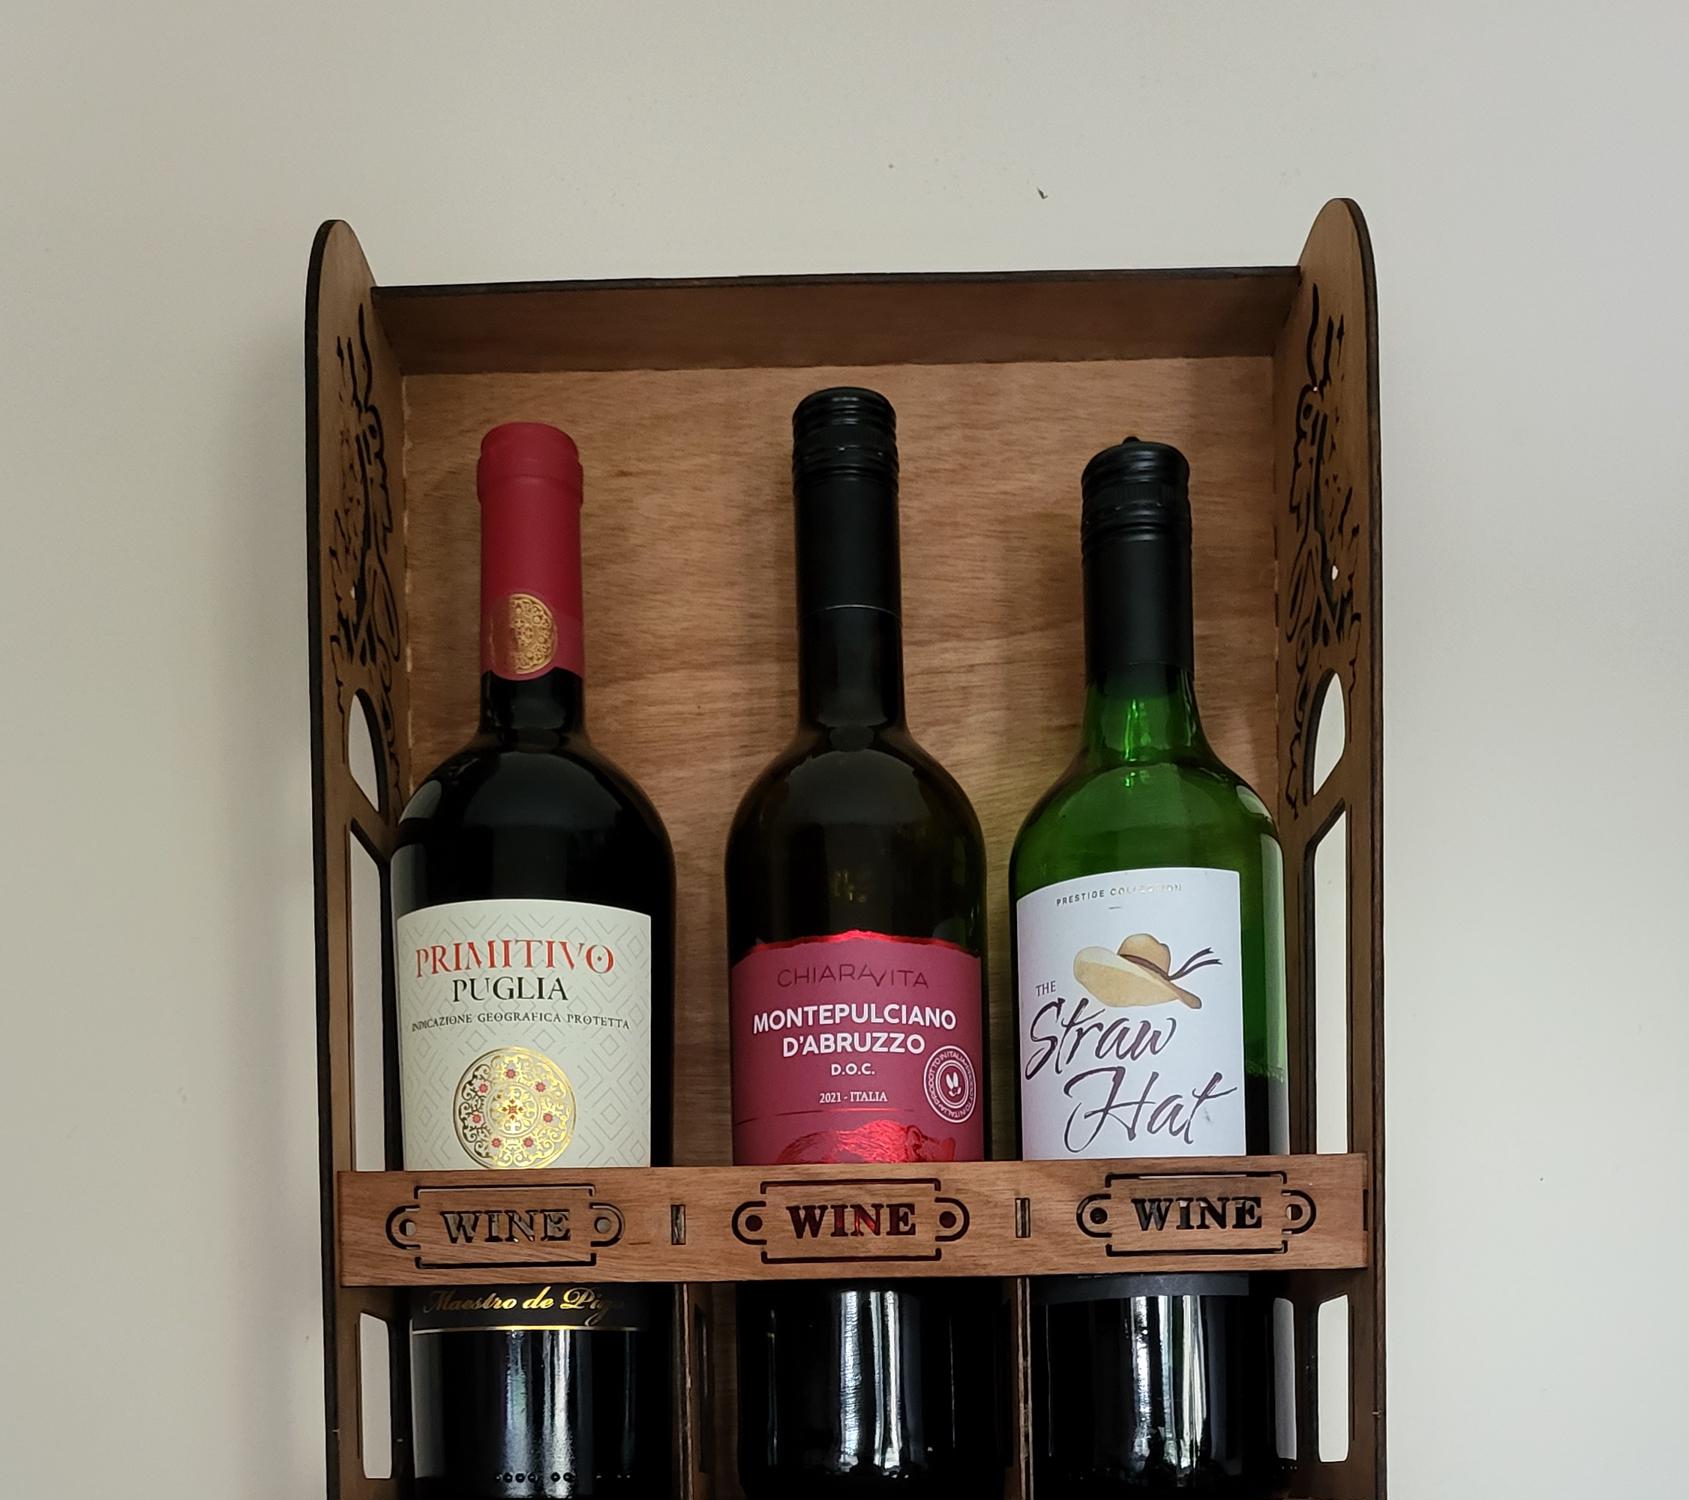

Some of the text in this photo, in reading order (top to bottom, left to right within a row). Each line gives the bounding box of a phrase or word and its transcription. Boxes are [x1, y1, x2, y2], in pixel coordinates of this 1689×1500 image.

[1056, 889, 1105, 907] PRESTIGE
[415, 939, 615, 978] PRIMITIVO
[452, 975, 568, 1002] PUGLIA
[776, 963, 929, 989] CHIARAVITA
[1035, 980, 1057, 997] THE
[411, 1011, 630, 1032] INDICAZIONE GEOGRAFICA PROTETTA
[753, 1003, 957, 1035] MONTEPULCIANO
[782, 1032, 926, 1058] D'ABRUZZO
[1025, 997, 1177, 1081] Straw
[831, 1063, 876, 1077] D.O.C.
[819, 1092, 841, 1104] 2021
[850, 1091, 888, 1103] ITALIA
[1063, 1066, 1238, 1153] Hat
[440, 1209, 572, 1244] WINE
[785, 1203, 917, 1239] WINE
[1131, 1196, 1264, 1231] WINE
[423, 1289, 518, 1313] Maestro
[522, 1286, 555, 1310] de
